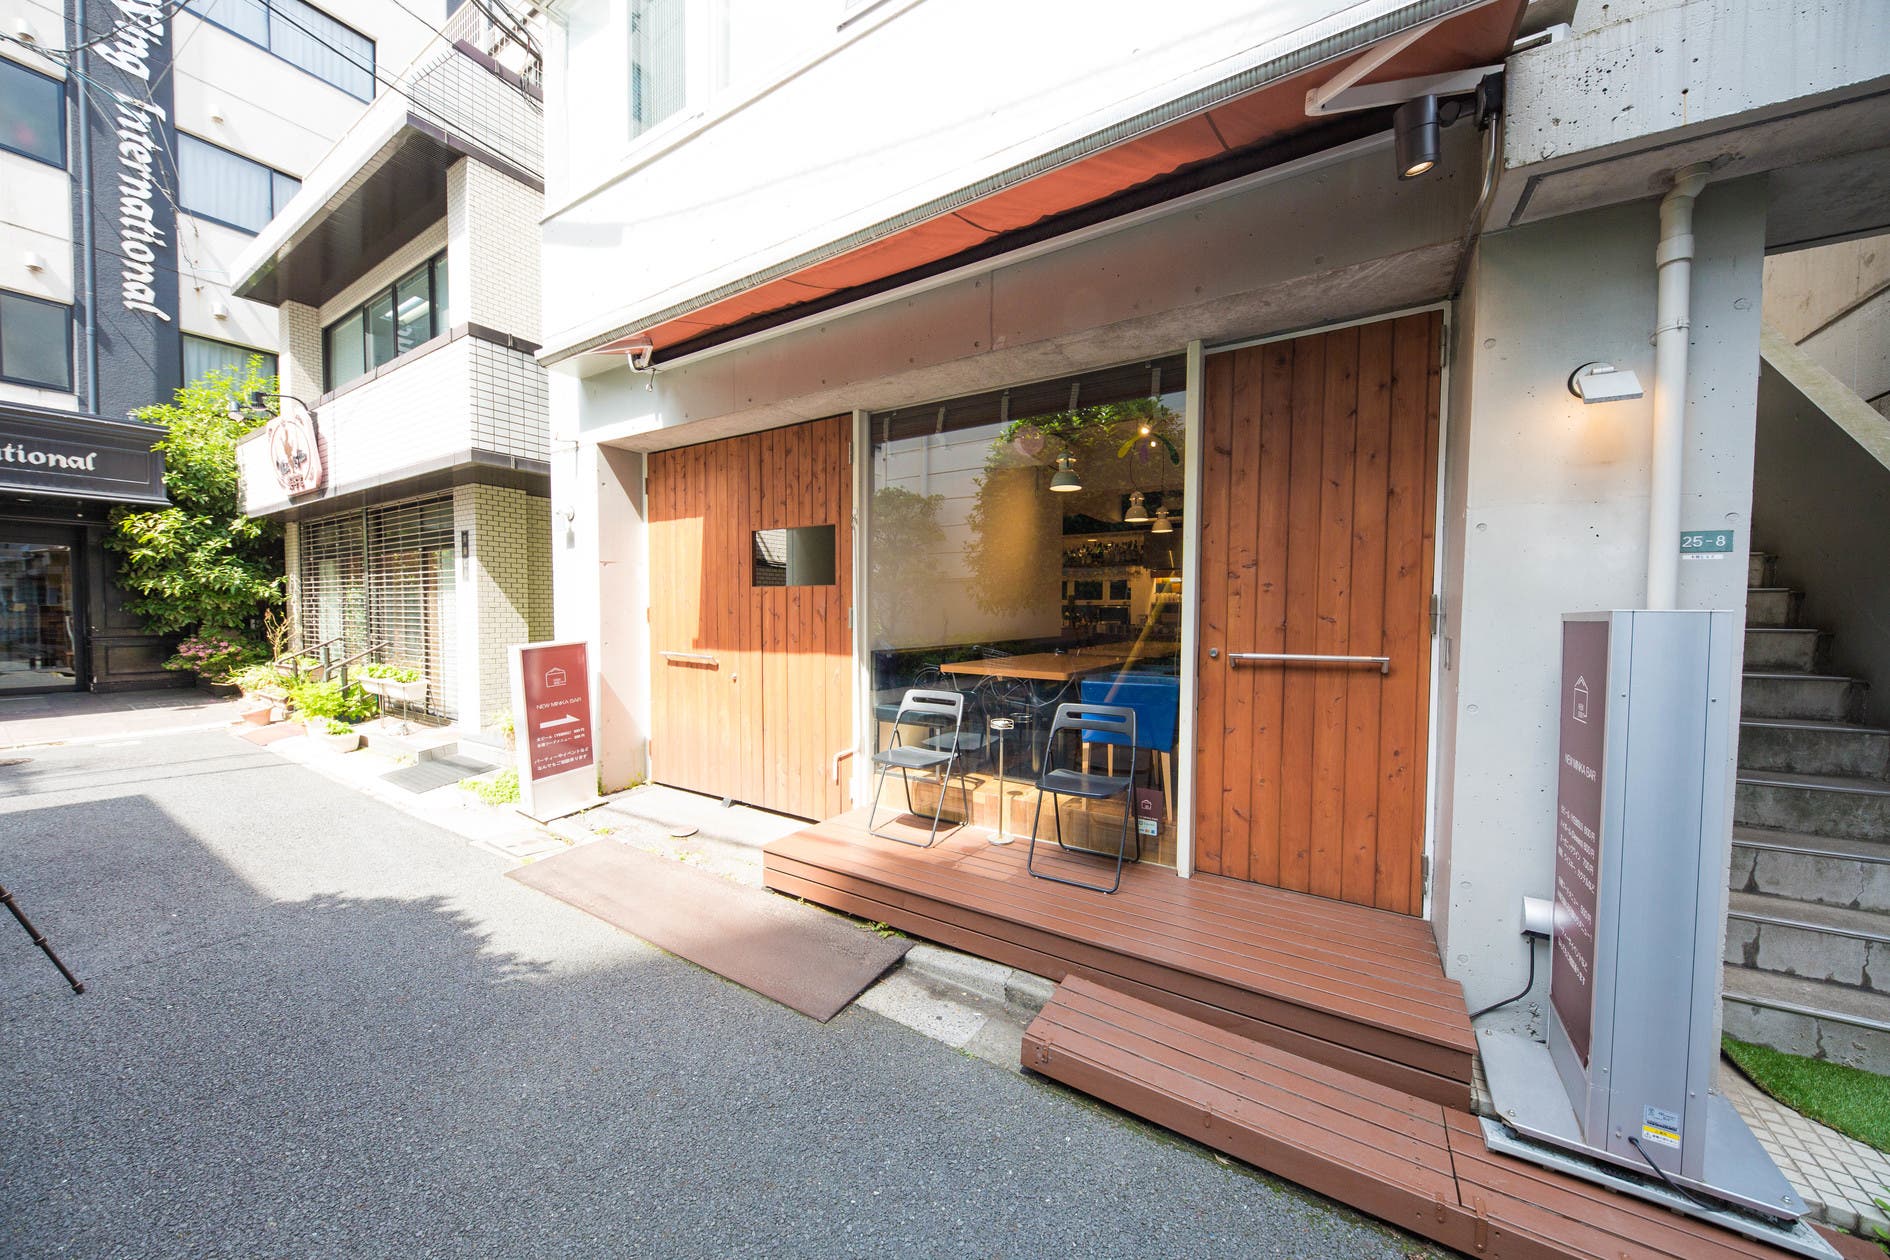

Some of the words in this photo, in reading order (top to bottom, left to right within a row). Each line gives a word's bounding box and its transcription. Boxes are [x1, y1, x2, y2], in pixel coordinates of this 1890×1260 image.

[112, 90, 171, 322] International
[0, 442, 98, 471] tional
[536, 702, 550, 710] NEW
[1585, 765, 1597, 782] BAR
